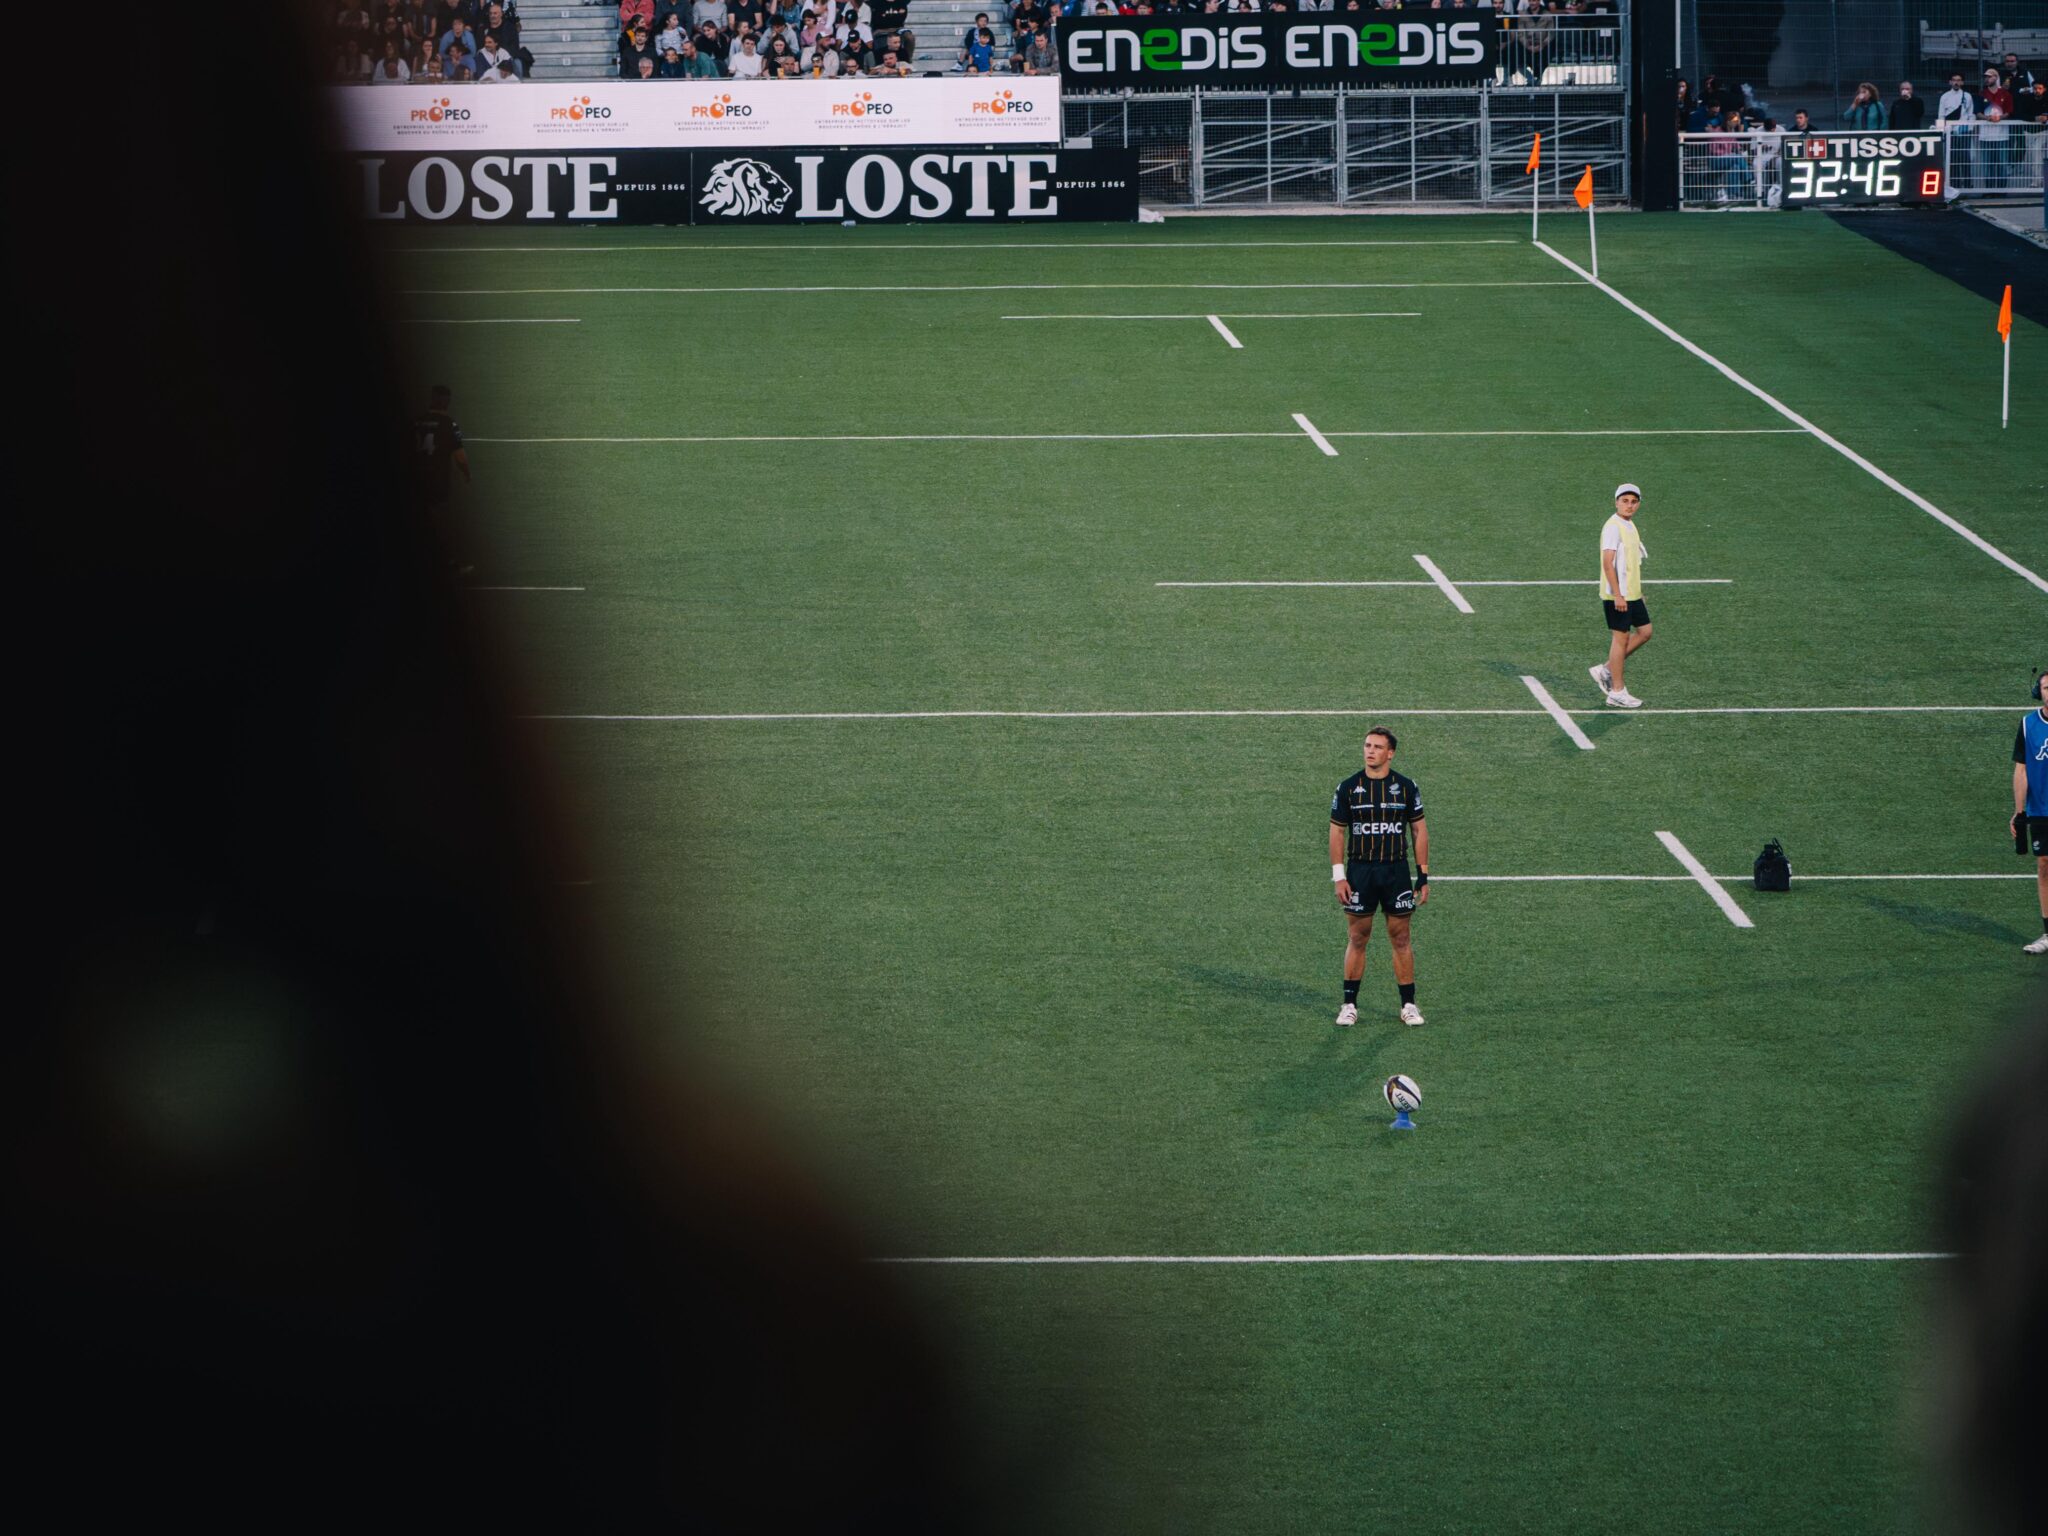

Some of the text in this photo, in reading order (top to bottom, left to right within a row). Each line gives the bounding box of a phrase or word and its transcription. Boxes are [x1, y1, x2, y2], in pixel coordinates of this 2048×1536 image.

[411, 106, 471, 122] PROPEO
[551, 104, 611, 120] PROPEO
[691, 102, 752, 118] PROPEO
[832, 100, 893, 116] PROPEO
[973, 98, 1033, 114] PROPEO
[1828, 136, 1941, 158] TISSOT
[795, 154, 1125, 219] LOSTE DEPUIS 1866
[1788, 160, 1940, 198] 32:46 8
[356, 156, 685, 220] LOSTE DEPUIS 1866
[1361, 822, 1402, 834] CEPAC
